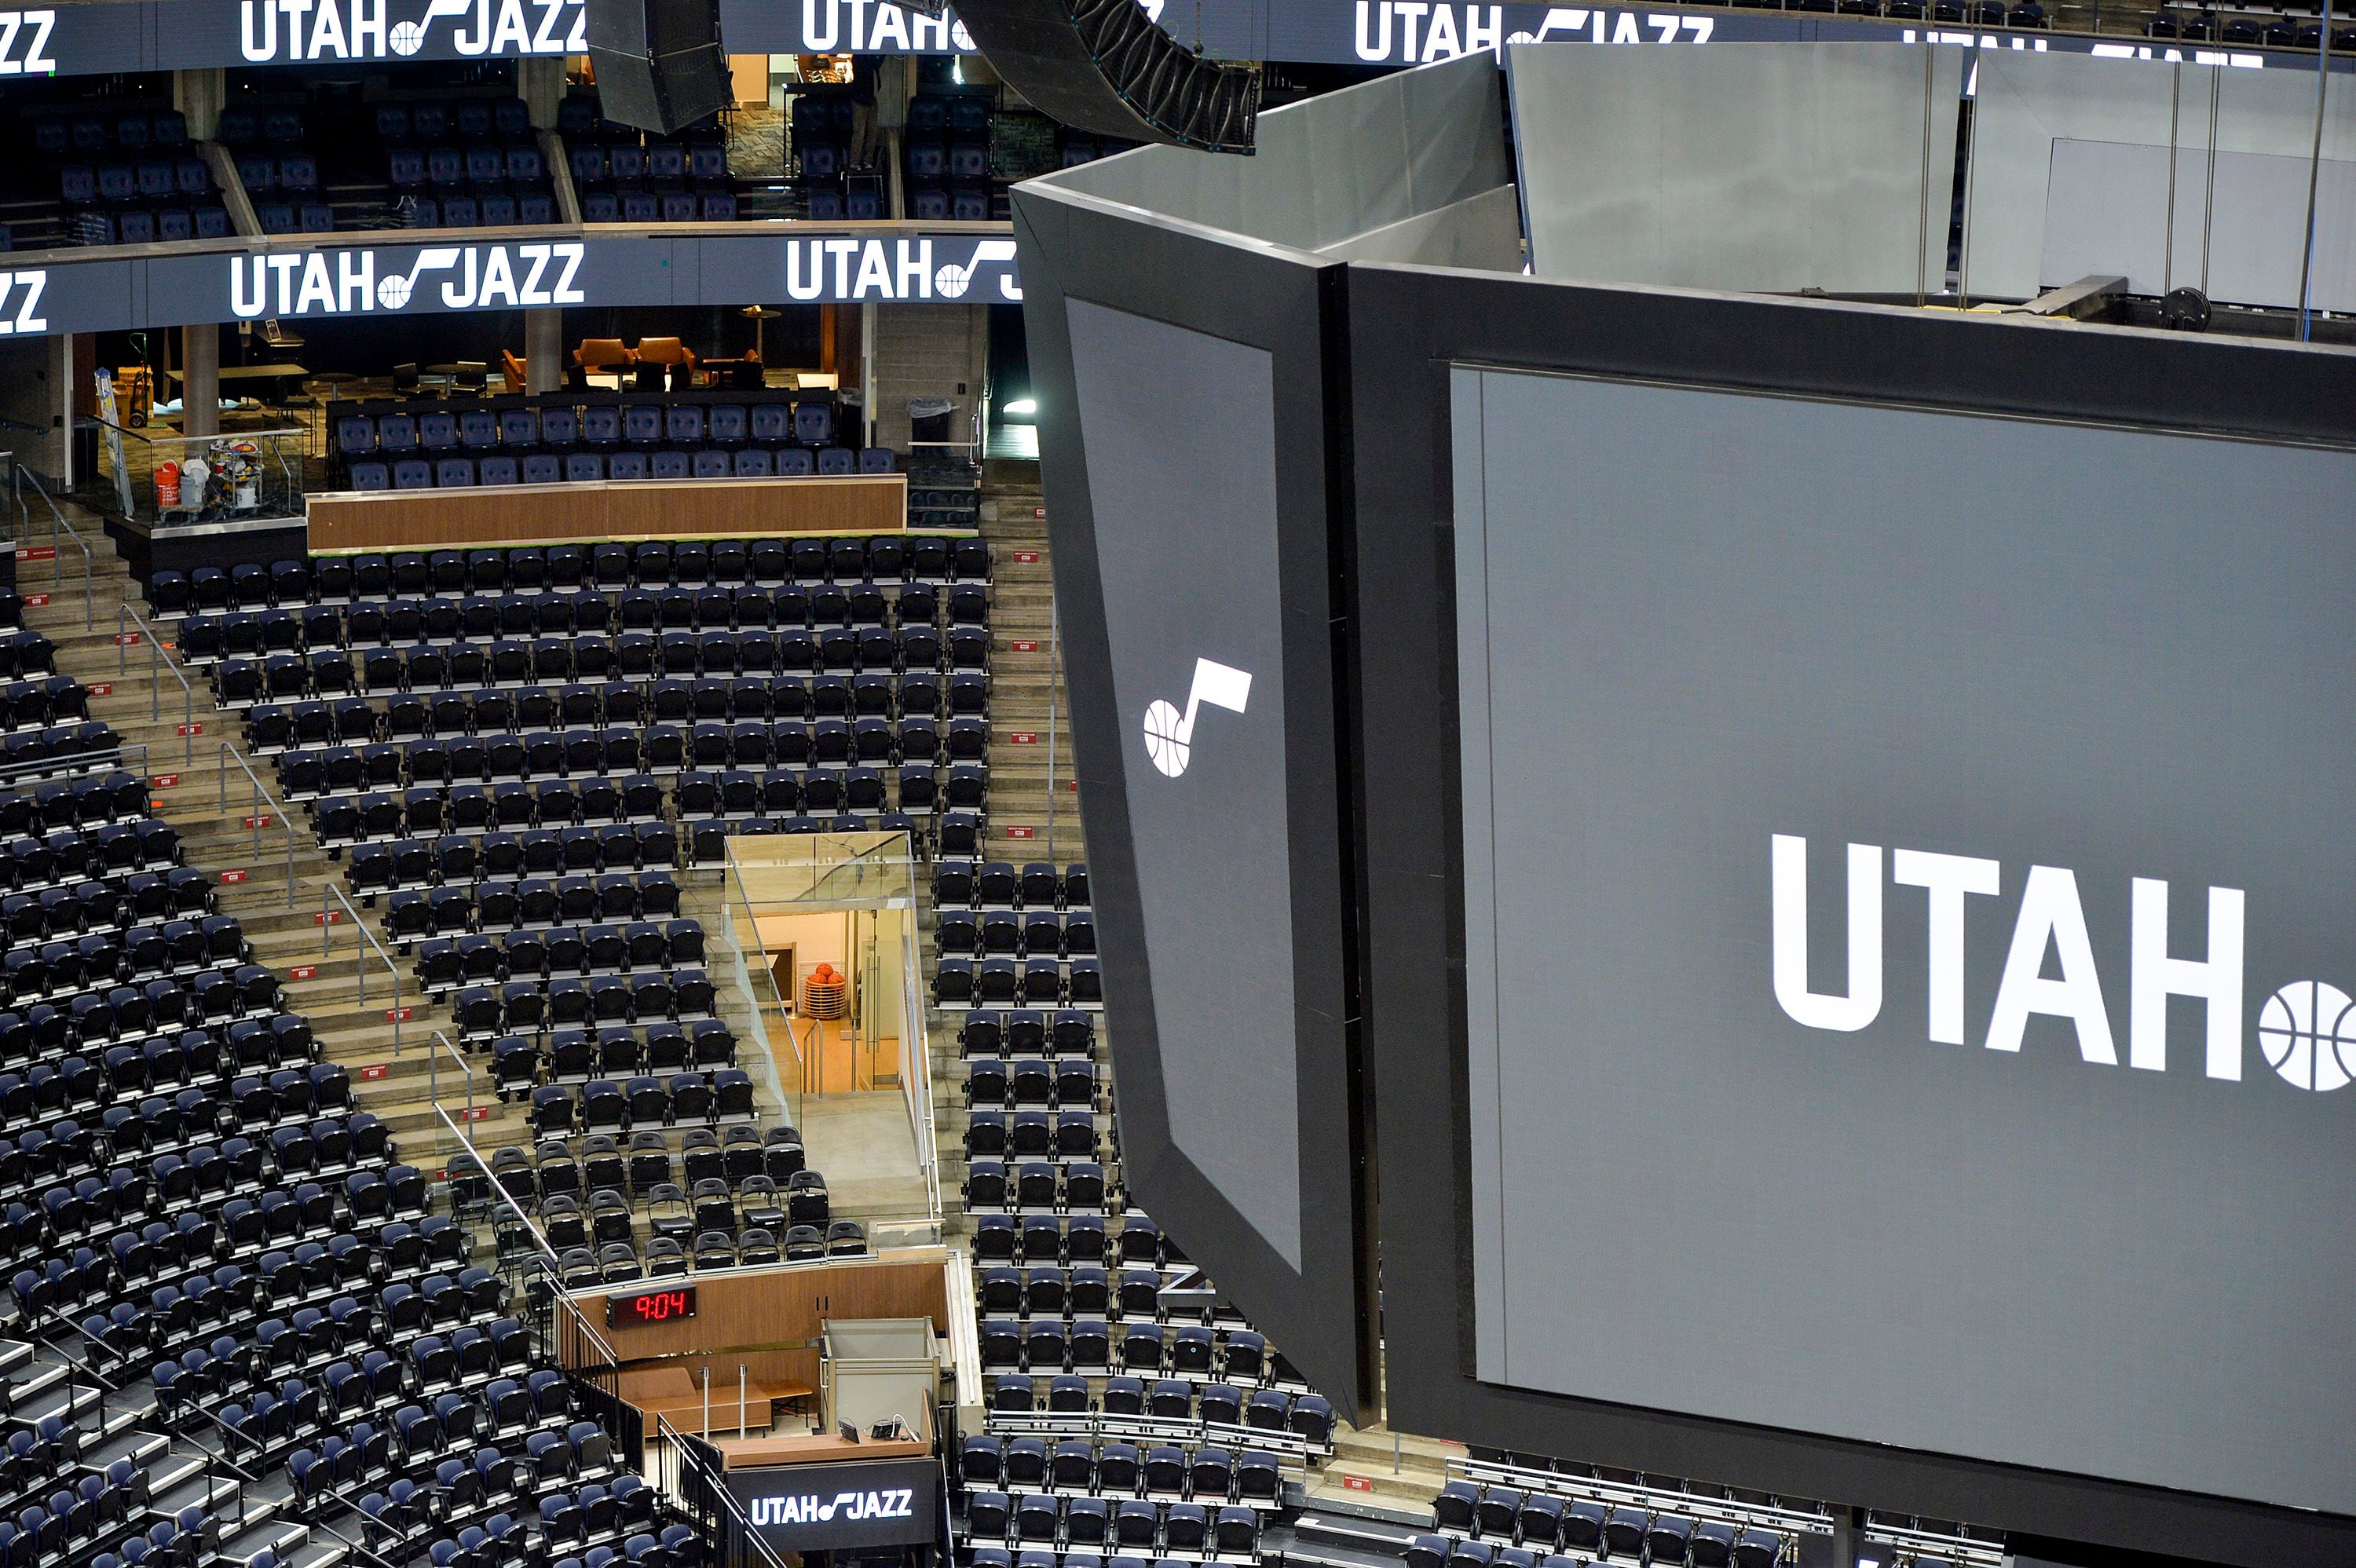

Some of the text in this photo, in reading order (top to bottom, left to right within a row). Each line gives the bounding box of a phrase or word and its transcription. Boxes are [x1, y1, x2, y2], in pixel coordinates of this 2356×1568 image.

[242, 0, 588, 61] UTAH JAZZ
[803, 0, 948, 50] UTAH
[1355, 1, 1502, 65] UTAH
[231, 243, 584, 316] UTAH JAZZ
[788, 239, 931, 299] UTAH
[1772, 834, 2244, 1081] UTAH
[637, 1292, 684, 1319] 9:04
[752, 1489, 912, 1525] UTAH JAZZ
